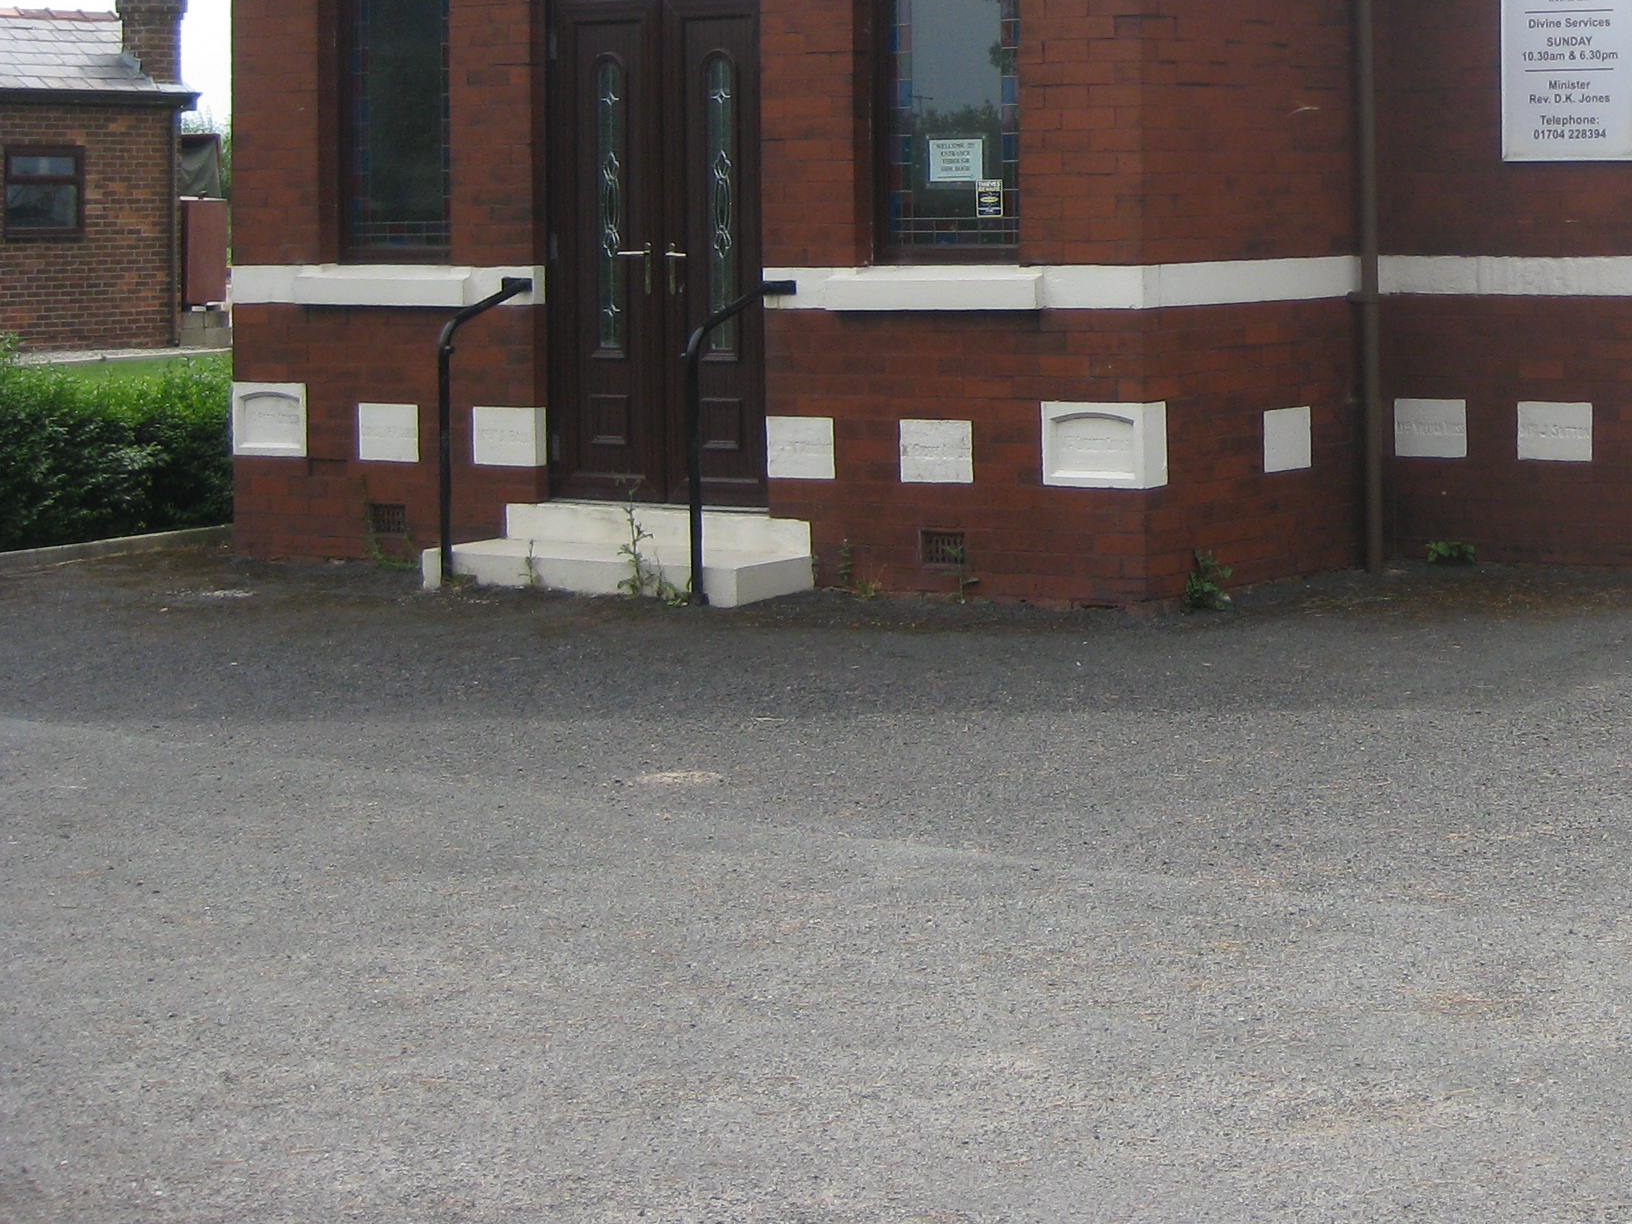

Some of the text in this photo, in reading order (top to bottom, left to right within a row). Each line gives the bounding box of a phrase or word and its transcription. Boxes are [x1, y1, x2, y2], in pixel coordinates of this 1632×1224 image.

[1528, 17, 1611, 29] Divine Services
[1546, 36, 1592, 47] SUNDAY
[1522, 49, 1618, 62] 10.30am & 6.30pm
[1548, 80, 1591, 90] Minister
[1529, 93, 1611, 104] Rev. D.K. Jones
[1540, 115, 1600, 127] Telephone:
[1533, 128, 1607, 140] 01704 228394
